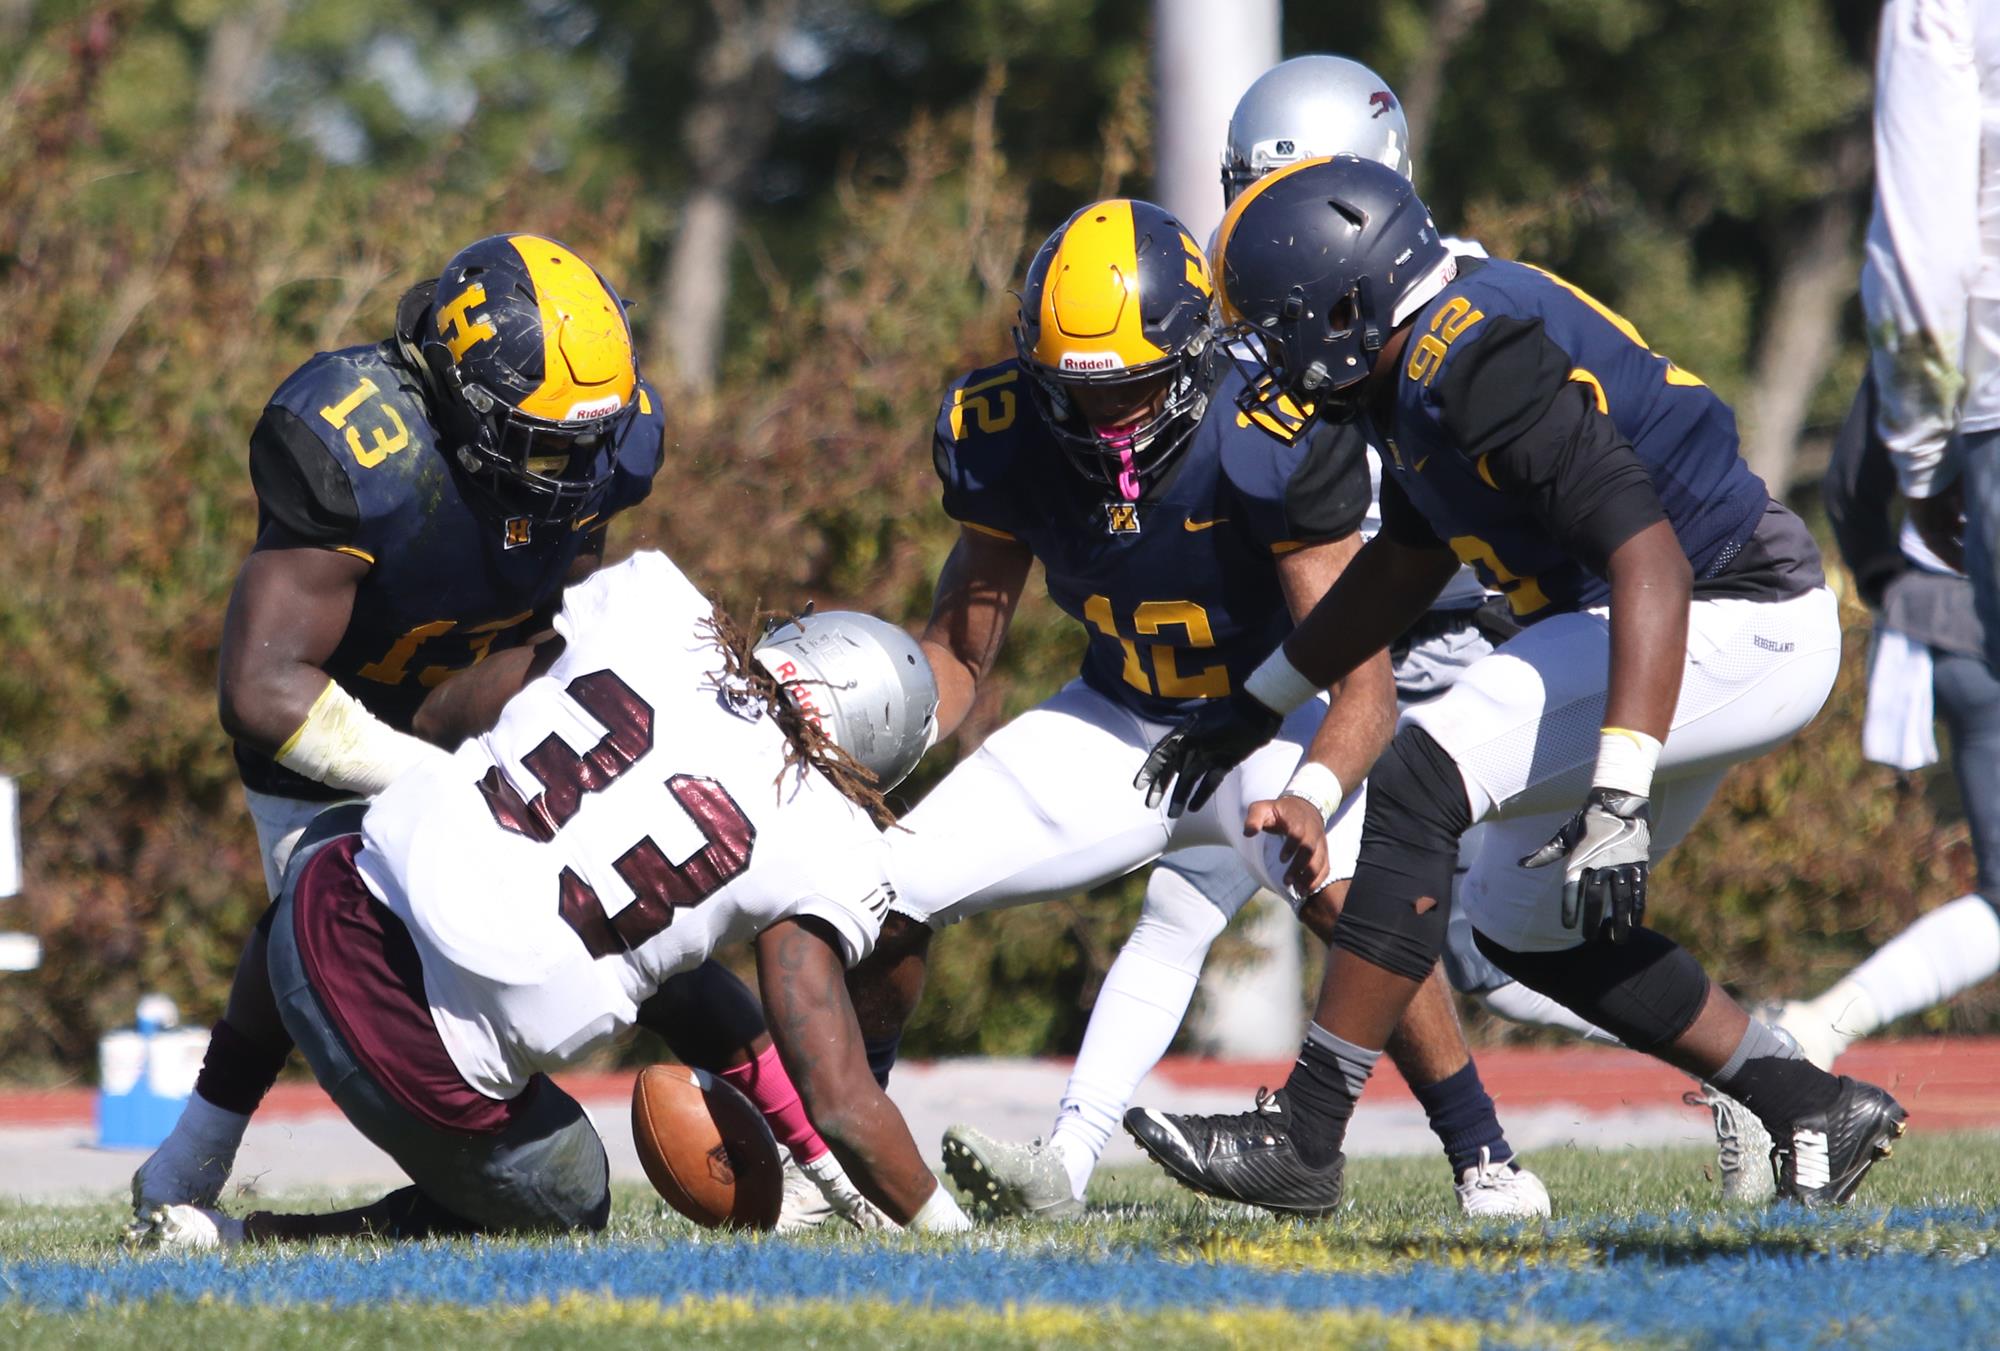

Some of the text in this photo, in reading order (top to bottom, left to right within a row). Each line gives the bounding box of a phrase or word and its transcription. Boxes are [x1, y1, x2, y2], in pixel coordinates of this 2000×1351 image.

[436, 283, 498, 365] H
[1065, 358, 1113, 370] Riddell
[1408, 296, 1485, 387] 92
[319, 378, 409, 469] 13
[577, 403, 618, 419] Riddell
[1084, 594, 1231, 698] 12
[474, 668, 757, 961] 33
[1793, 1129, 1831, 1190] NIKE
